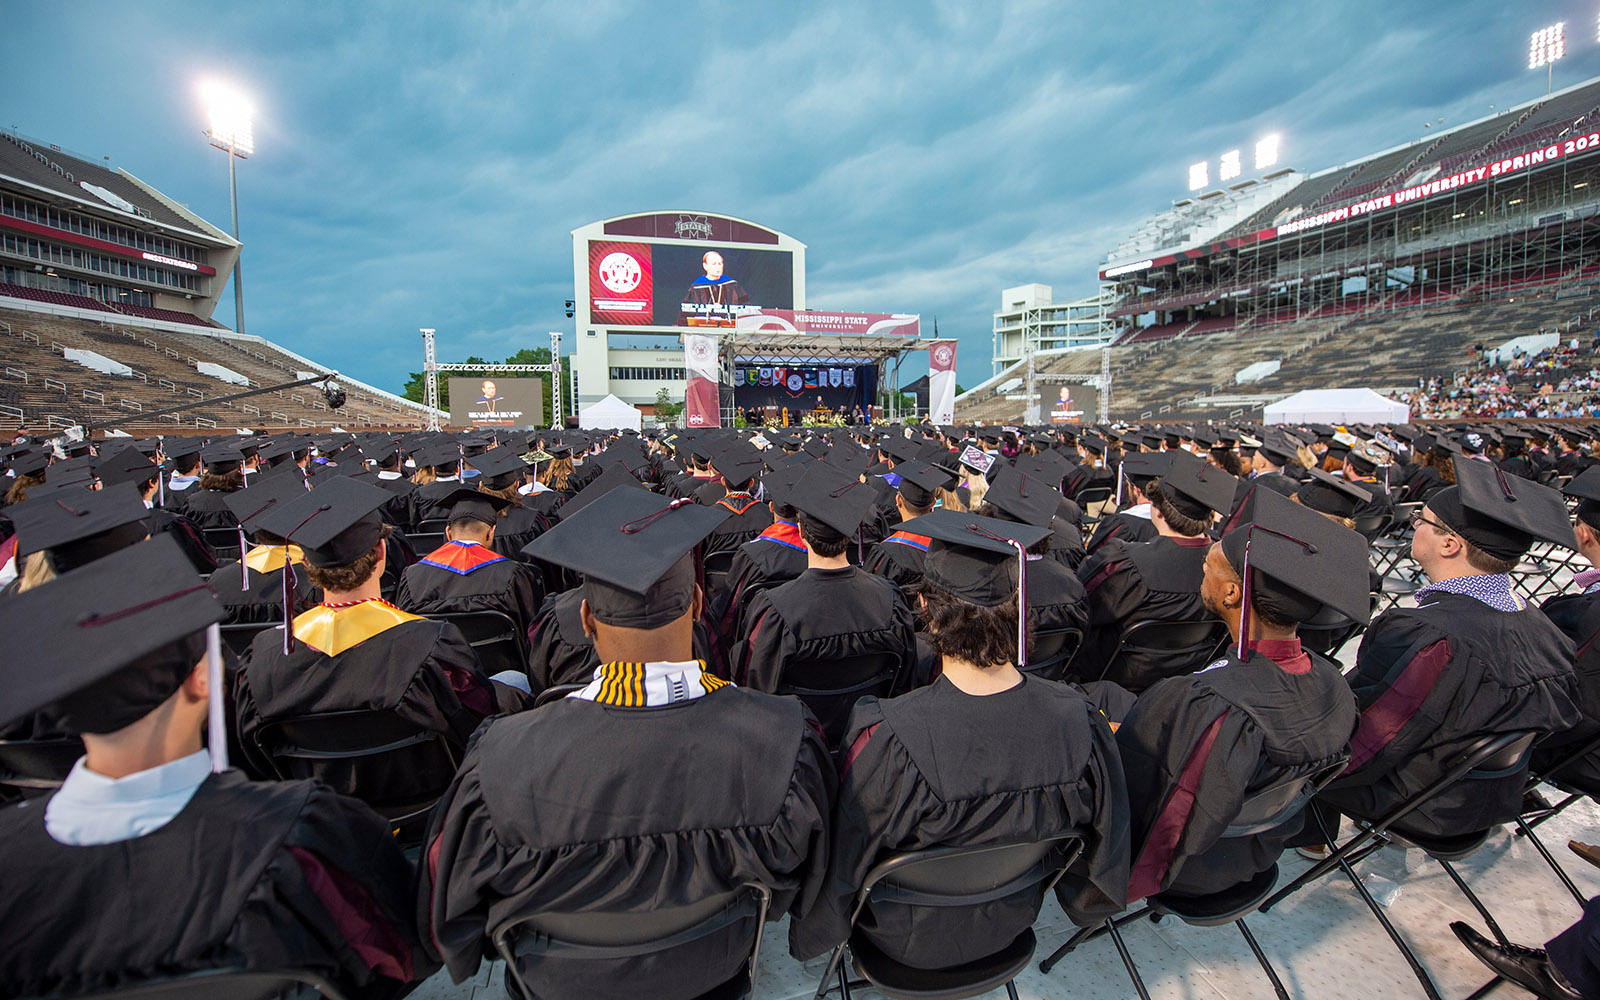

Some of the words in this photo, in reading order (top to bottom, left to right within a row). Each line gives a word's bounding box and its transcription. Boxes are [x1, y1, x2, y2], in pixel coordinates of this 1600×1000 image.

[1278, 207, 1349, 236] MISSISSIPPI
[1350, 195, 1392, 216] STATE
[1395, 166, 1486, 203] UNIVERSITY
[1490, 145, 1558, 176] SPRING
[1564, 132, 1600, 155] 202
[681, 222, 707, 233] STATE
[794, 314, 842, 324] MISSISSIPPI
[844, 316, 868, 325] STATE
